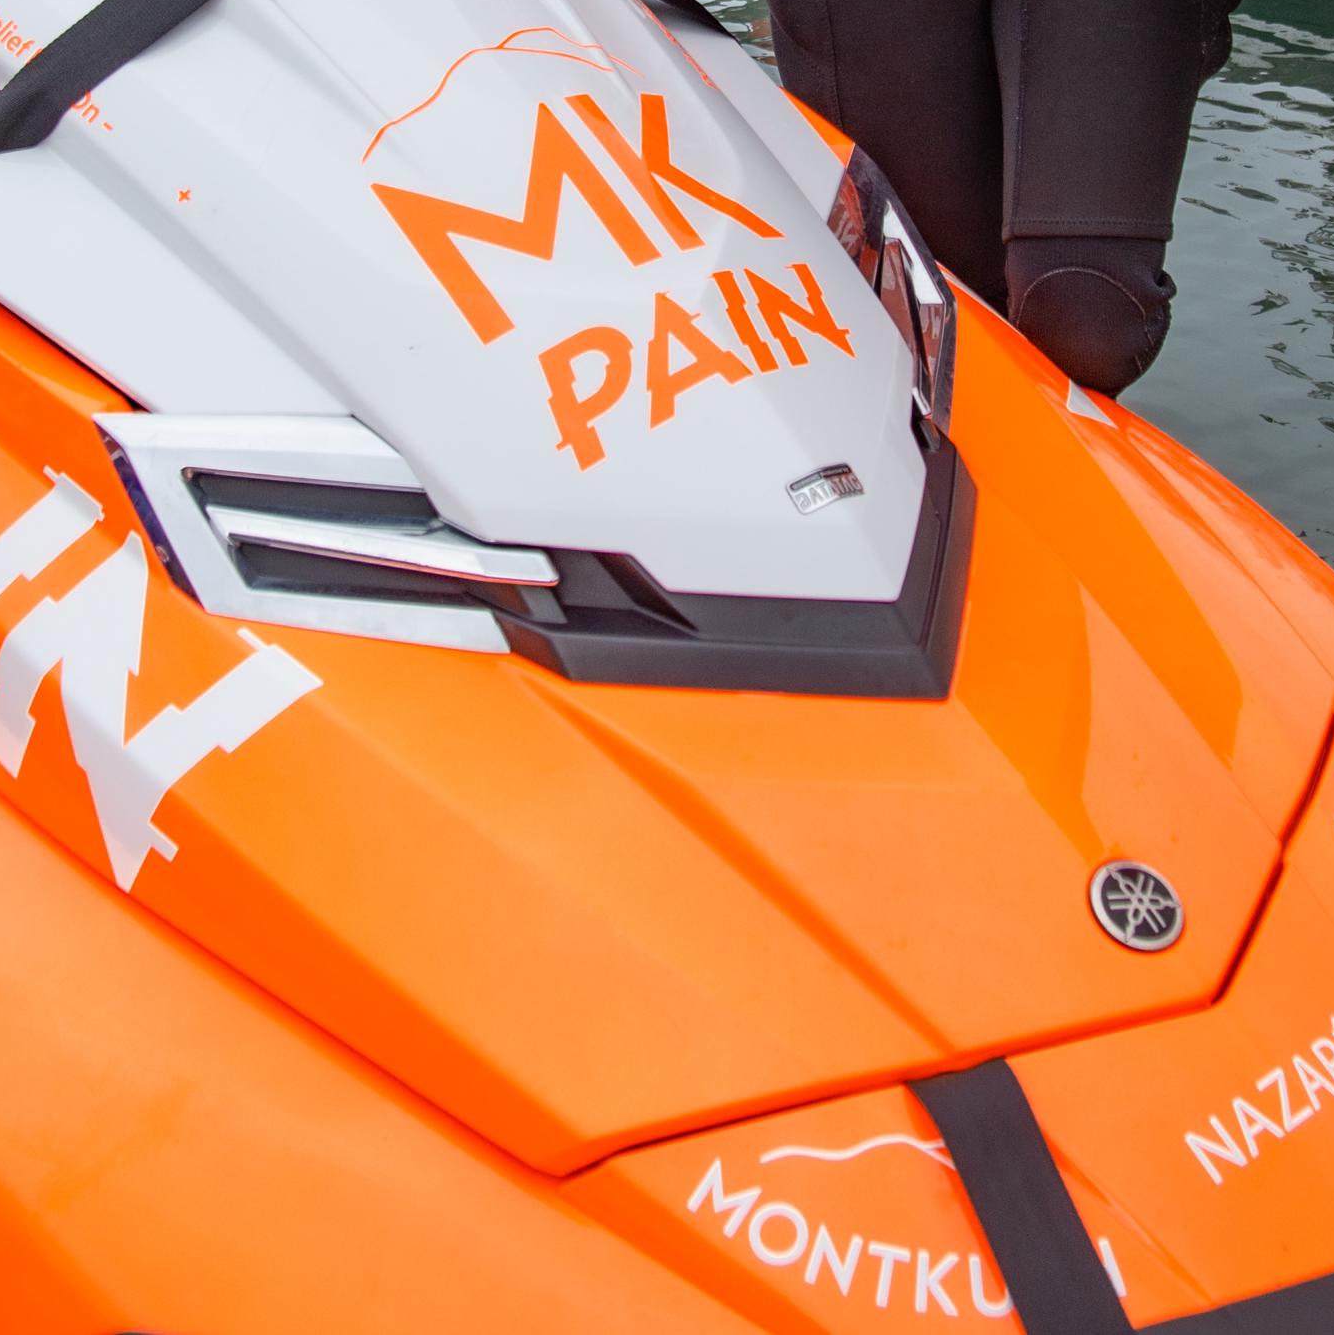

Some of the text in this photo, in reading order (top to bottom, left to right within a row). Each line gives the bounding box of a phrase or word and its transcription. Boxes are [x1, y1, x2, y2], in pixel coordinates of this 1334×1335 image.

[371, 92, 785, 345] MK
[537, 262, 857, 472] PAIN
[686, 1157, 1127, 1318] MONTKU
